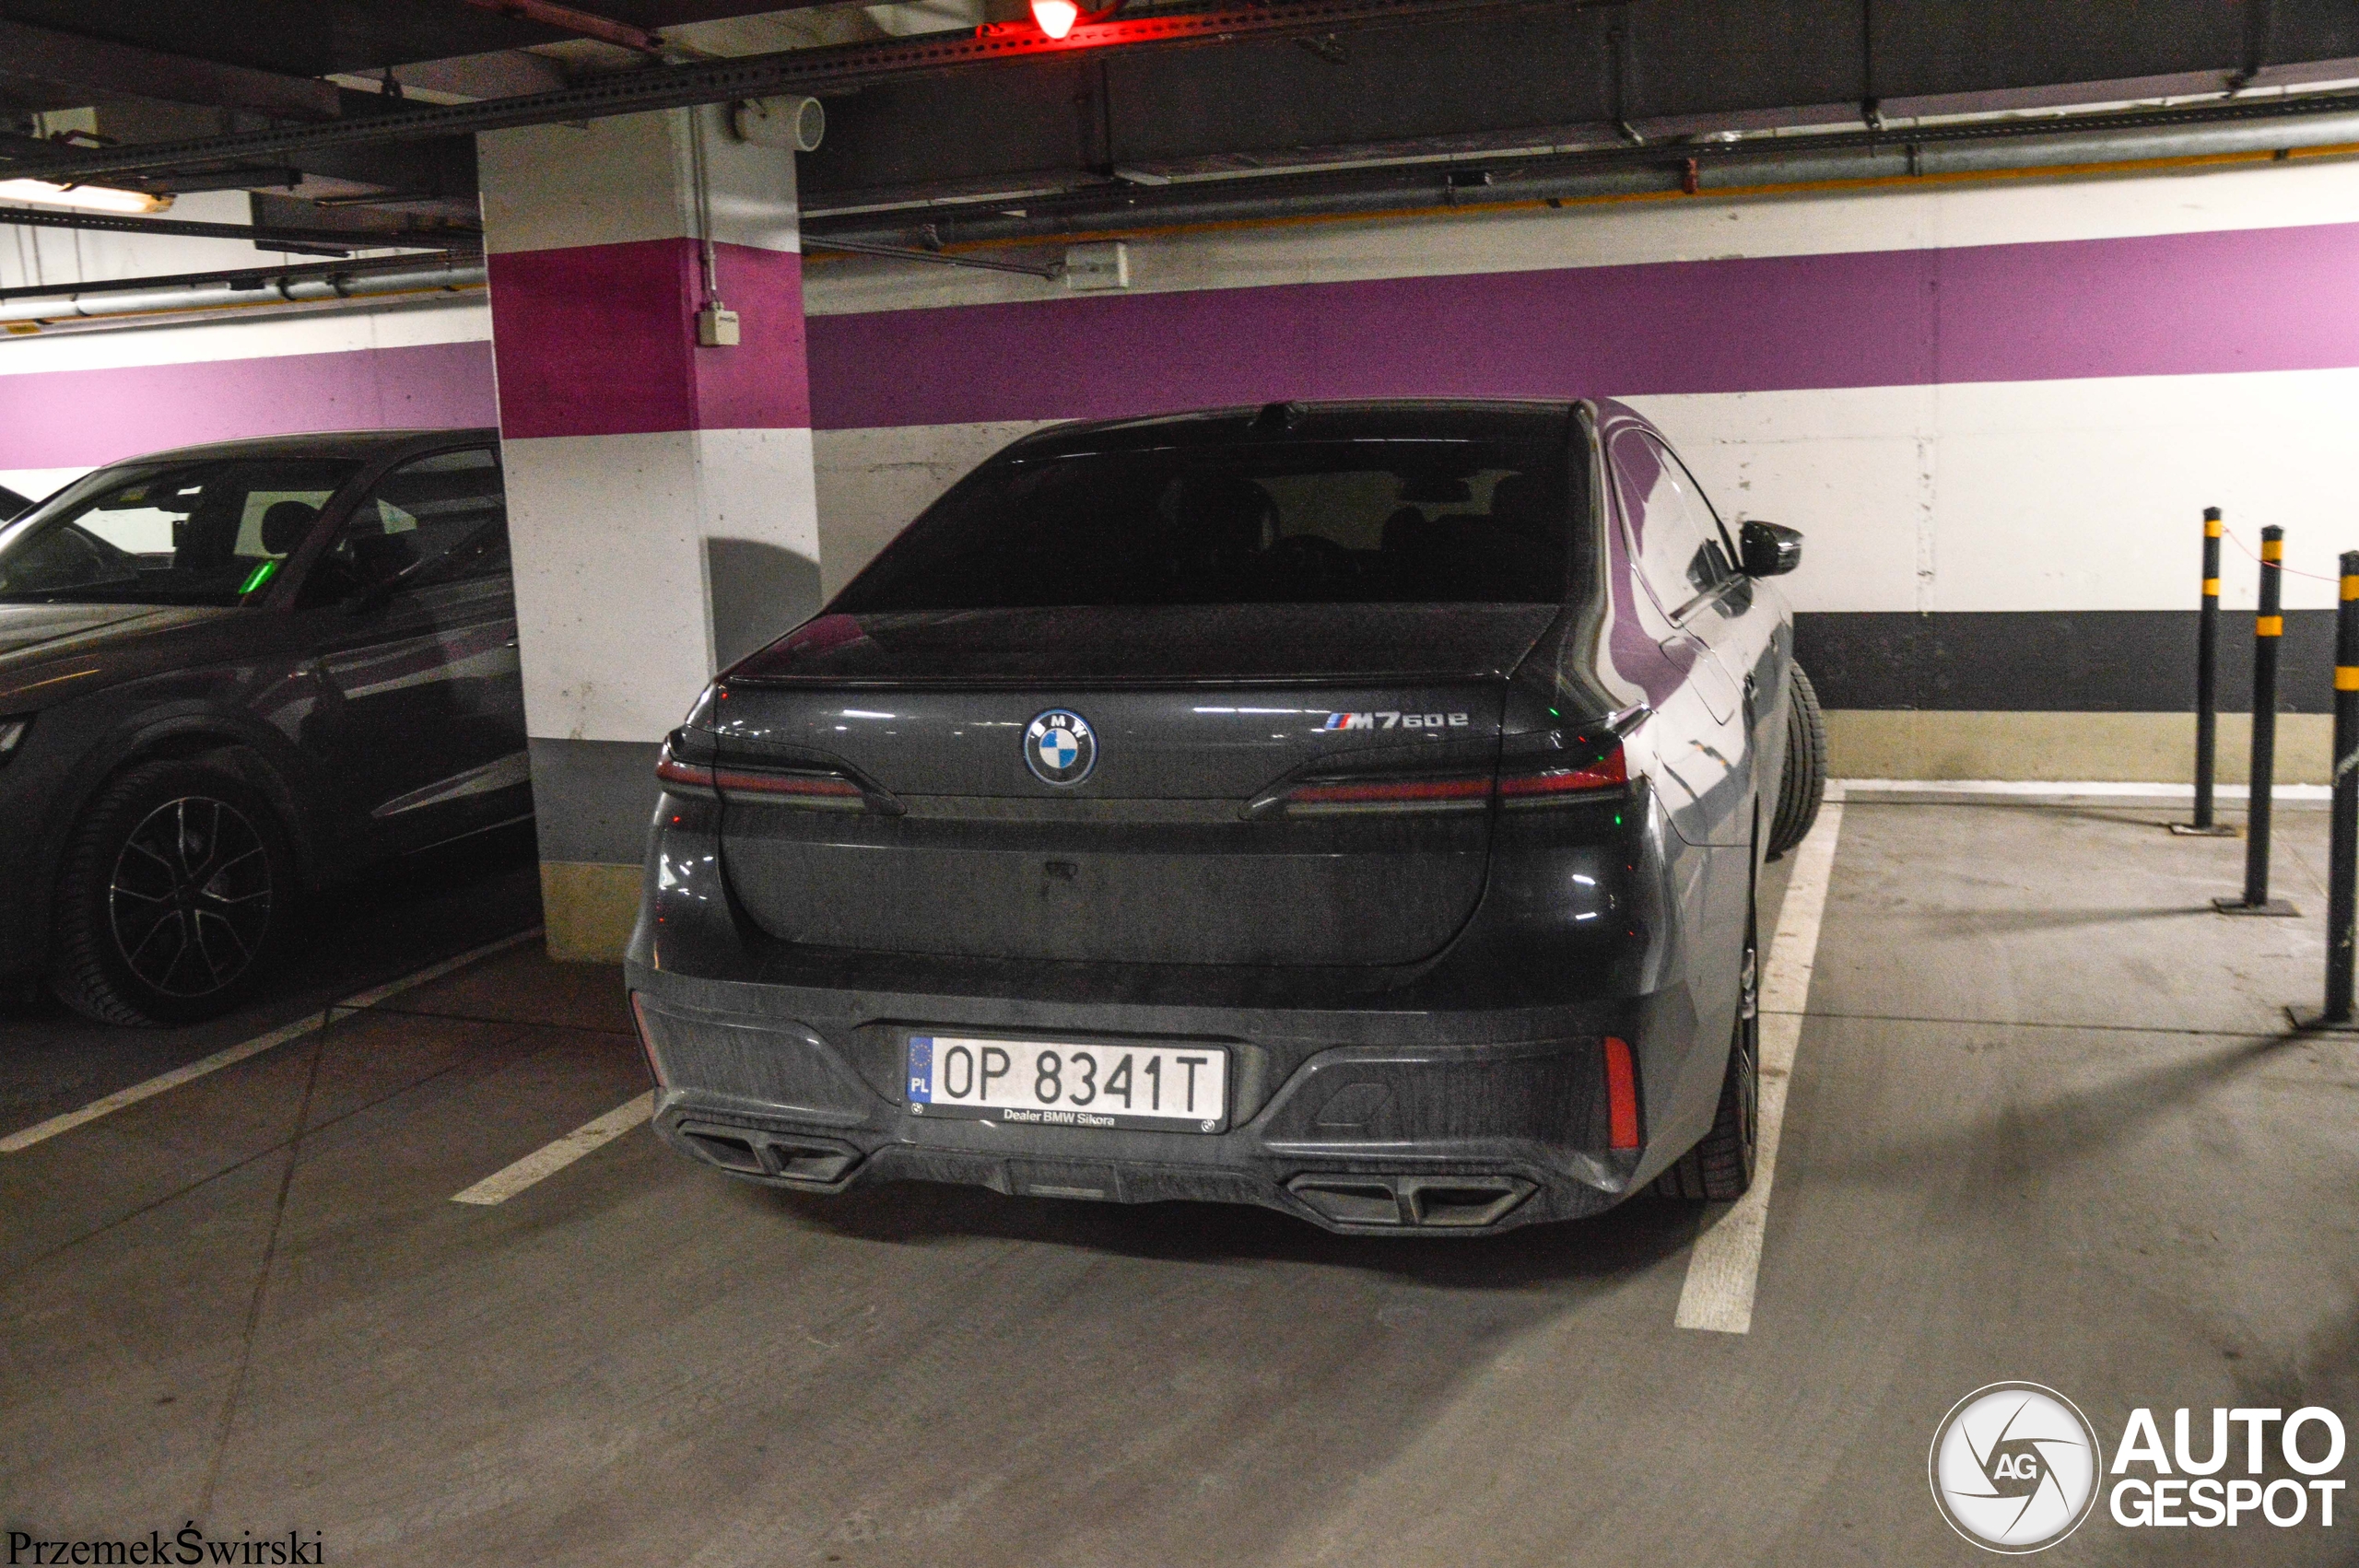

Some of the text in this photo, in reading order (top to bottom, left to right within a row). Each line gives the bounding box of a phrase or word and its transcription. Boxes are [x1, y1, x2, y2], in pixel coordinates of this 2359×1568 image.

[910, 1077, 929, 1094] PL
[944, 1046, 1208, 1113] OP 8341T
[1003, 1108, 1115, 1127] Dealer BMW Sikora
